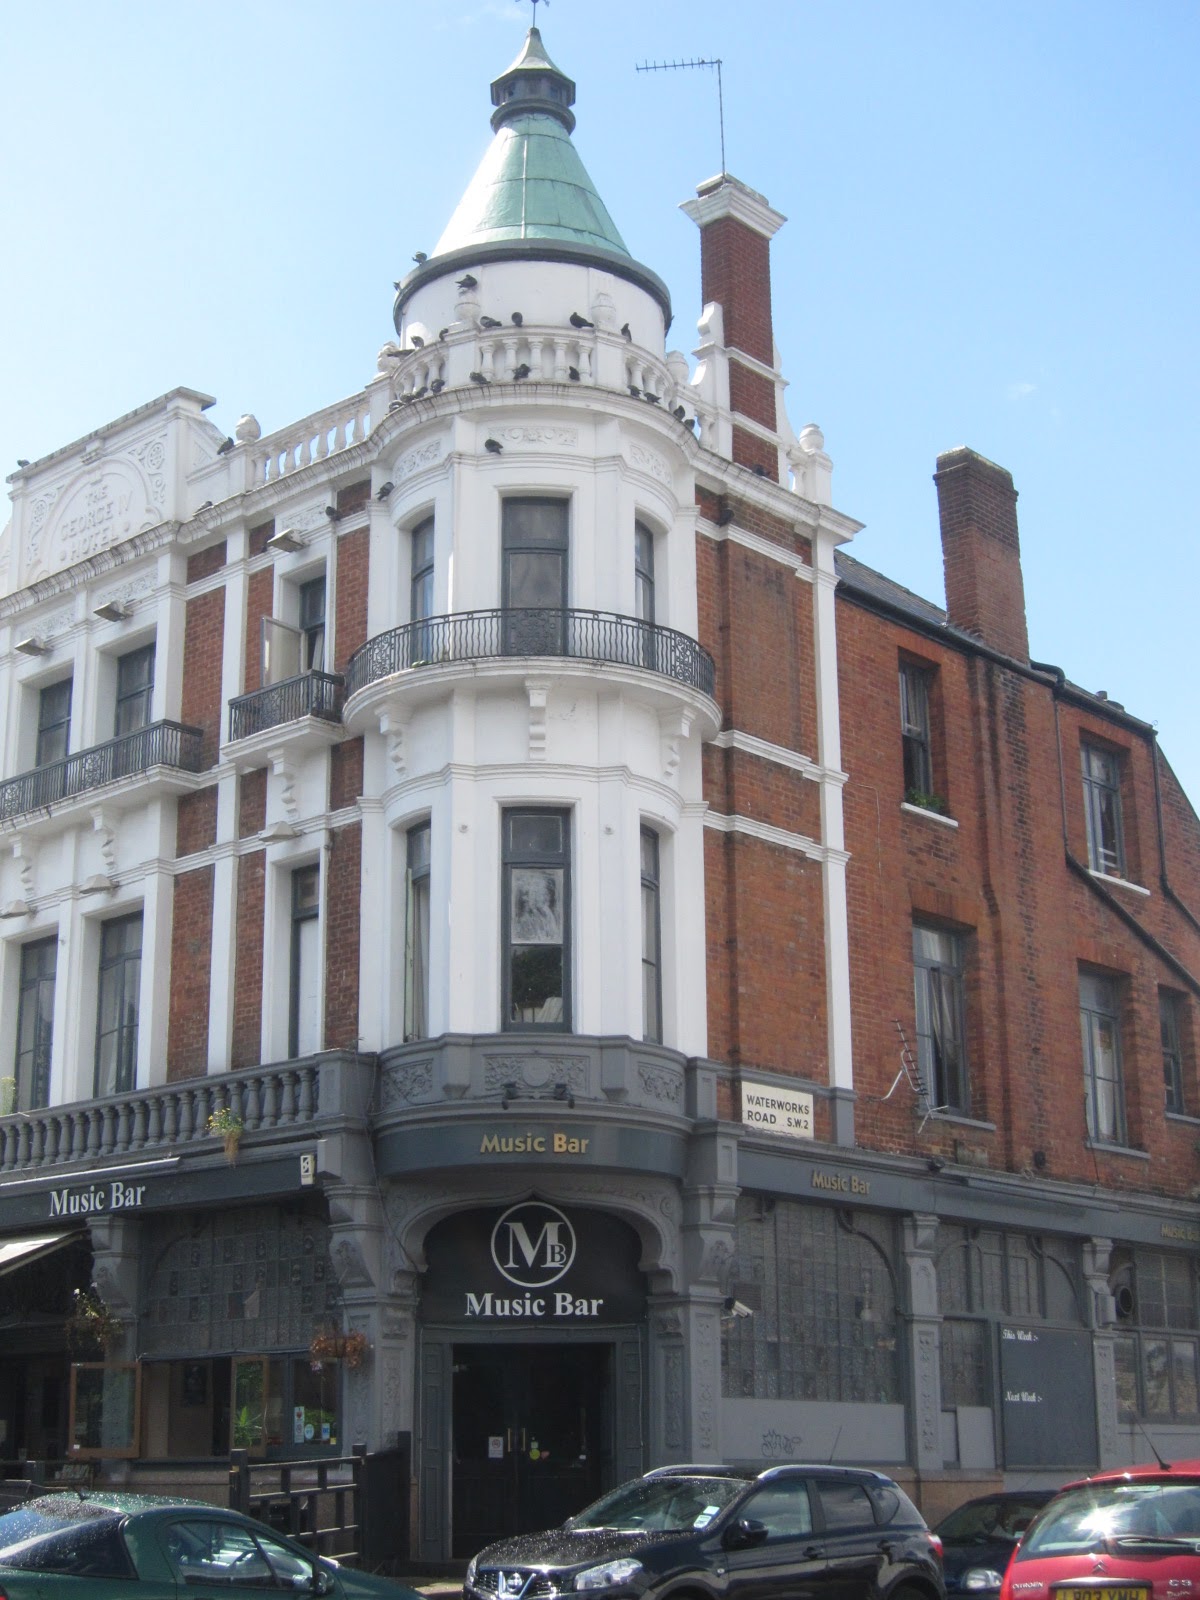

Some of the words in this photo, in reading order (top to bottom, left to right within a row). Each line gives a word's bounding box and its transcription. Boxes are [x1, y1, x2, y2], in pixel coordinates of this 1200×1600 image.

[60, 501, 114, 541] GEORGE
[69, 523, 120, 561] HOTEL
[747, 1094, 810, 1115] WATERWORKS
[747, 1110, 777, 1125] ROAD
[786, 1117, 809, 1130] S.W.2
[480, 1133, 546, 1153] Music
[553, 1133, 589, 1153] Bar
[812, 1170, 848, 1191] Music
[850, 1176, 870, 1194] Bar
[49, 1185, 105, 1217] Music
[110, 1182, 146, 1209] Bar
[464, 1292, 546, 1316] Music
[553, 1292, 604, 1316] Bar
[1002, 1329, 1016, 1340] This
[1017, 1330, 1032, 1341] Week
[1005, 1391, 1020, 1402] Next
[1021, 1391, 1036, 1402] Week
